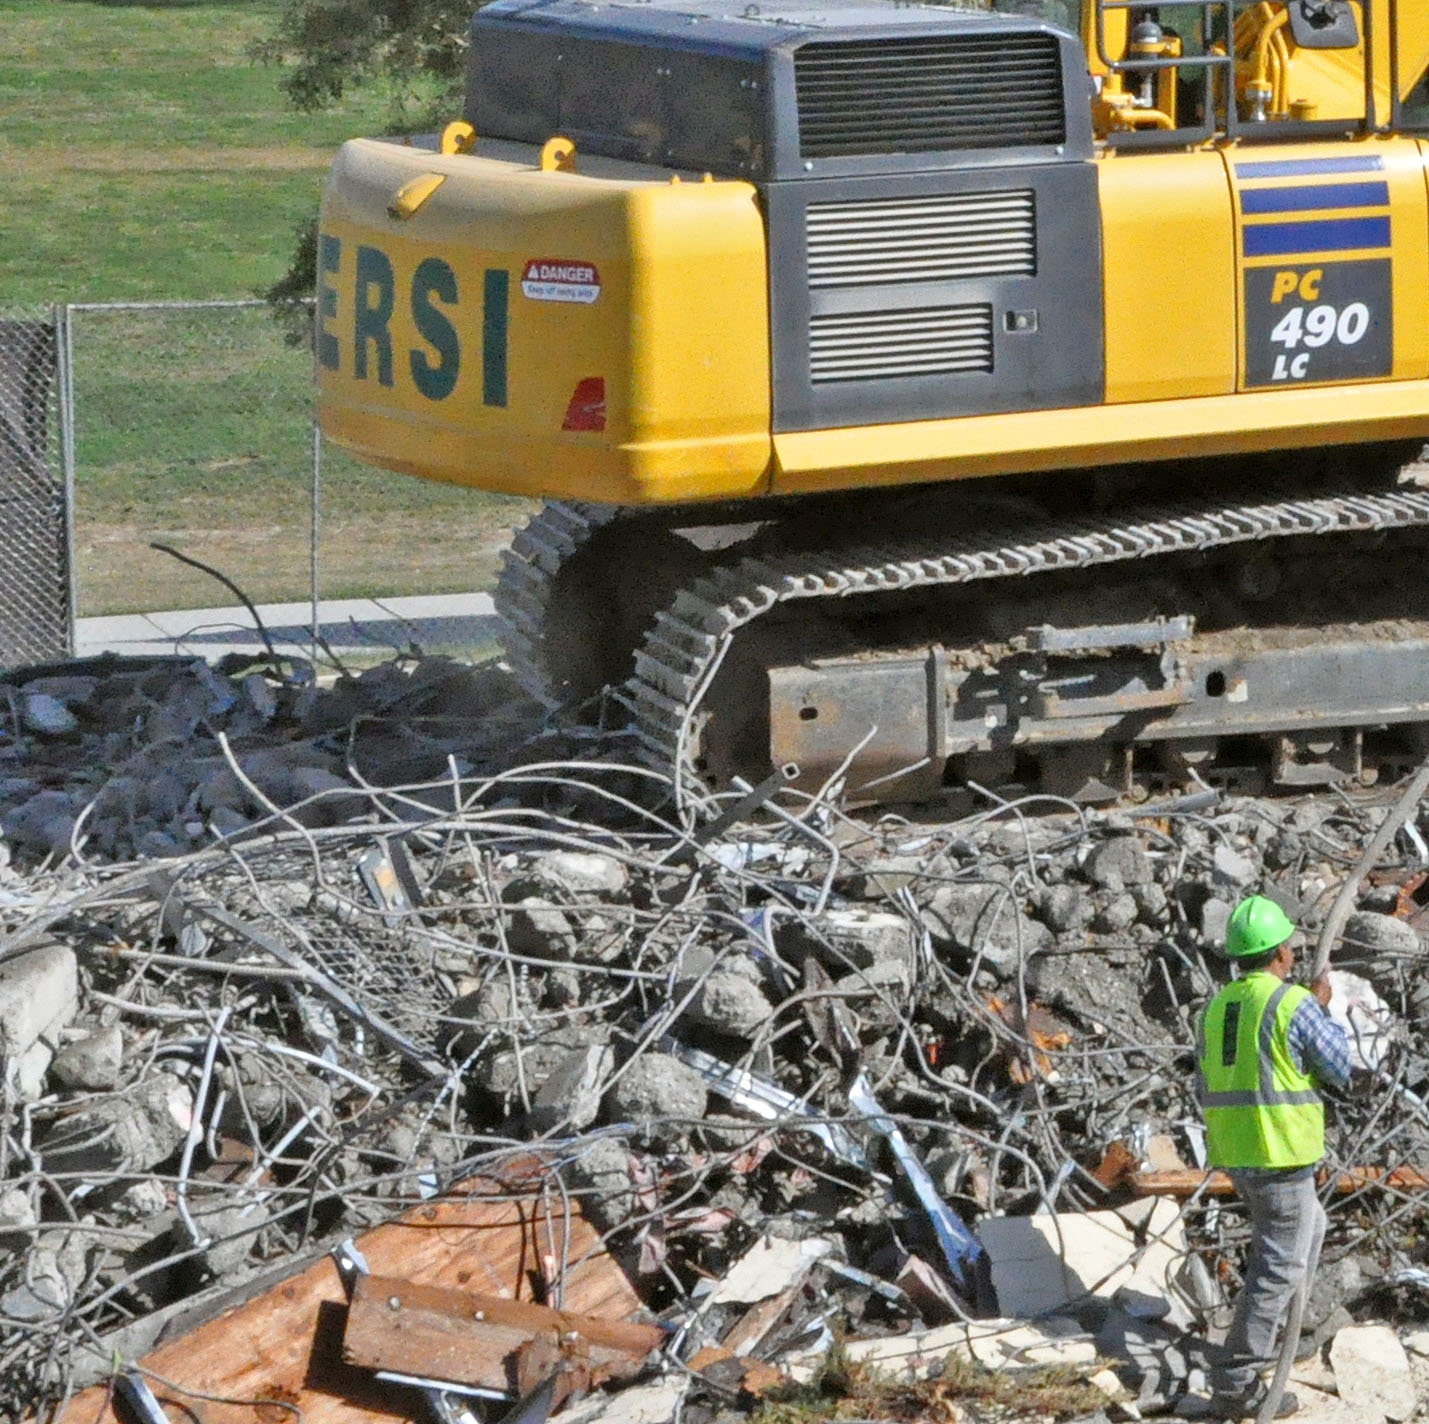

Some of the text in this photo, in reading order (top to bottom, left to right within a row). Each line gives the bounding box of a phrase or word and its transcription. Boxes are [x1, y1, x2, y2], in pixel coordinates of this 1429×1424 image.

[541, 265, 594, 282] DANGER
[1270, 269, 1324, 304] PC
[319, 233, 510, 409] ERSI
[1270, 302, 1370, 349] 490
[1271, 352, 1311, 381] LC
